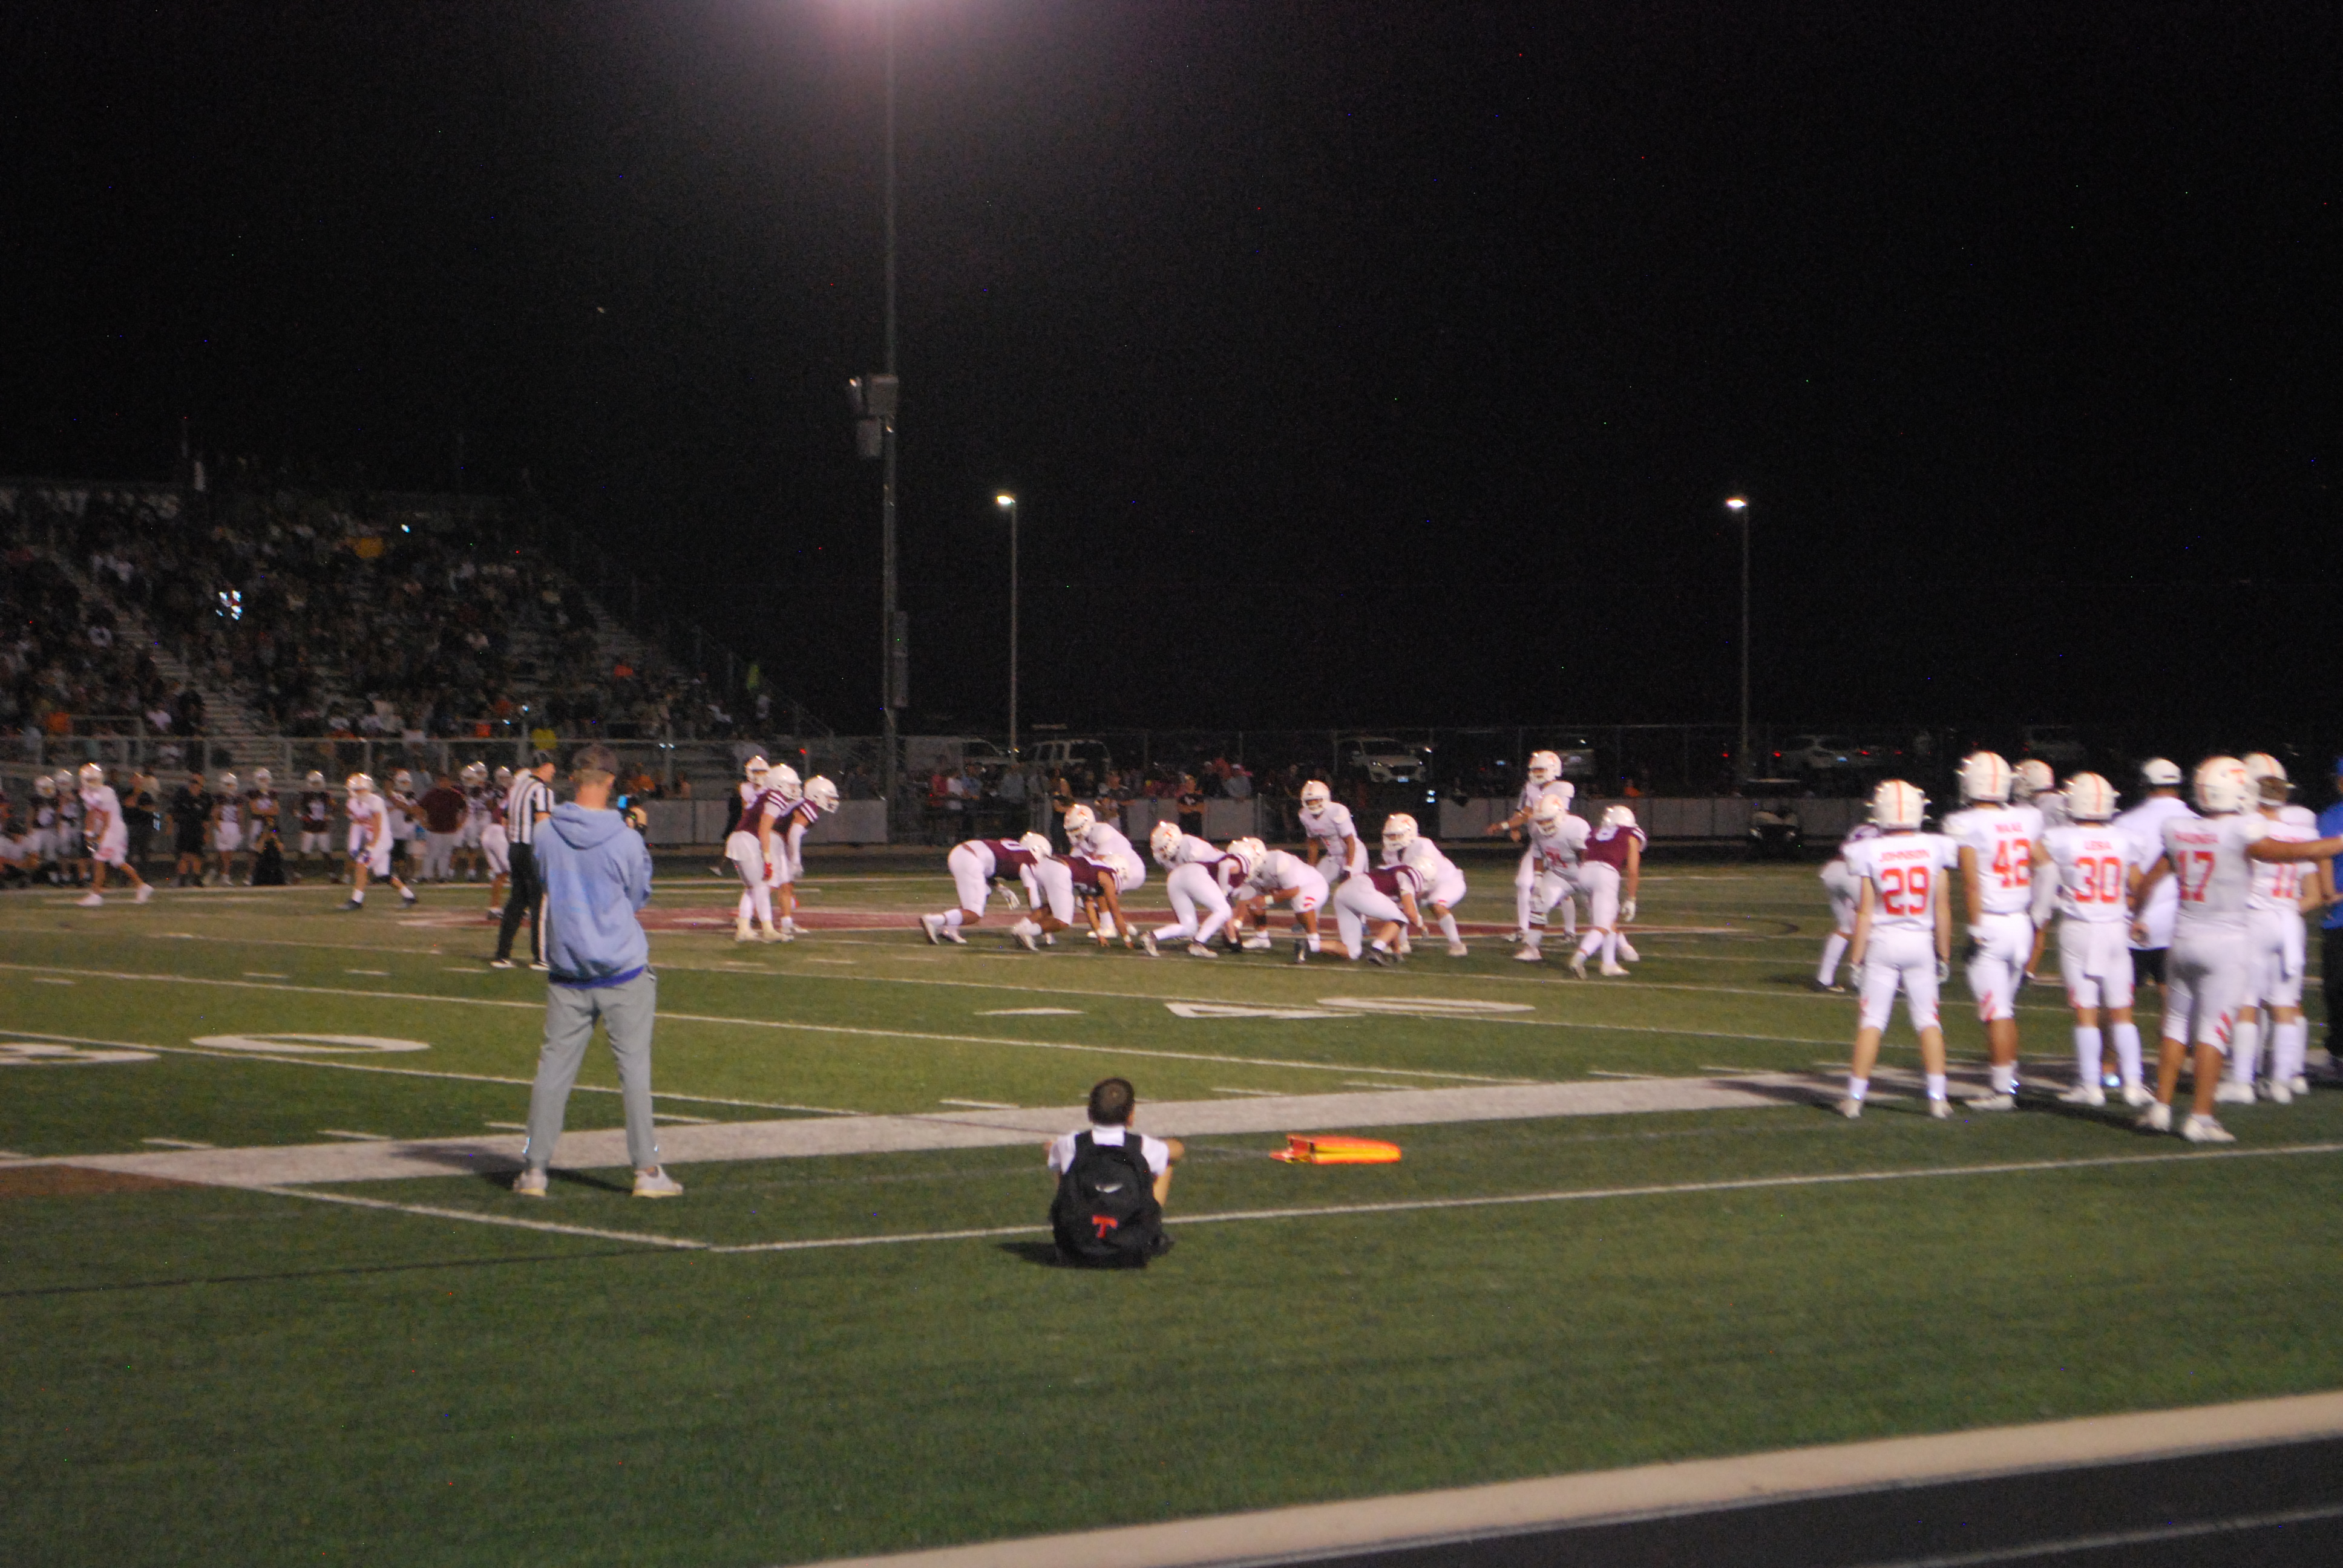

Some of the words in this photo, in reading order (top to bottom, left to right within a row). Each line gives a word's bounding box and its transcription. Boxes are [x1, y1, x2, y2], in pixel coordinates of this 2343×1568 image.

[1992, 838, 2032, 887] 42
[2074, 856, 2122, 903] 30
[2177, 849, 2215, 903] 17
[1880, 866, 1929, 916] 29
[1092, 1214, 1118, 1238] T
